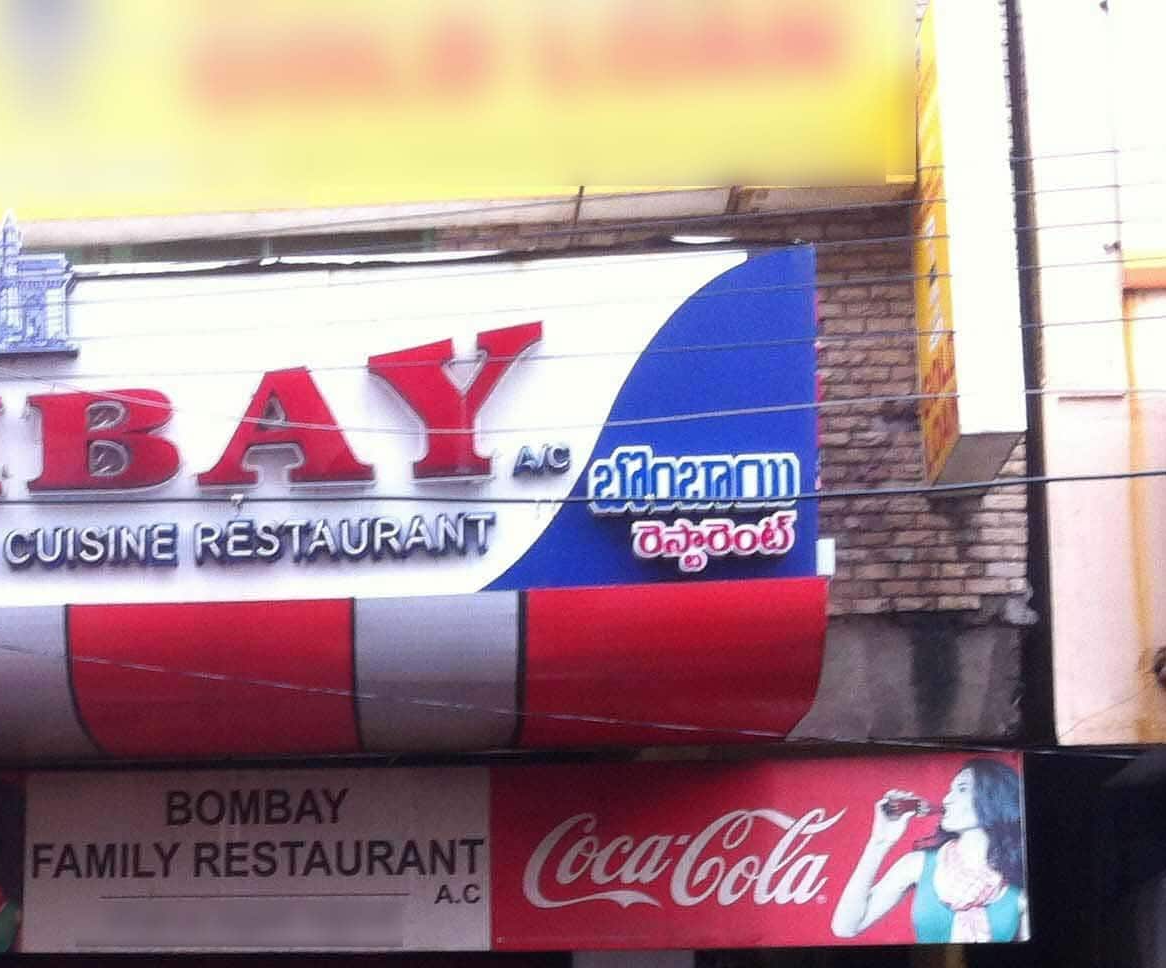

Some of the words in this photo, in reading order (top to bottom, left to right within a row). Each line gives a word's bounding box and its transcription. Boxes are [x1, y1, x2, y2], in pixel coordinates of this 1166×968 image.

[513, 445, 571, 475] A/C
[3, 524, 178, 570] CUISINE
[193, 512, 496, 567] RESTAURANT
[166, 788, 349, 826] BOMBAY
[30, 842, 181, 879] FAMILY
[193, 838, 485, 878] RESTAURANT
[522, 808, 848, 909] Coca-Cola
